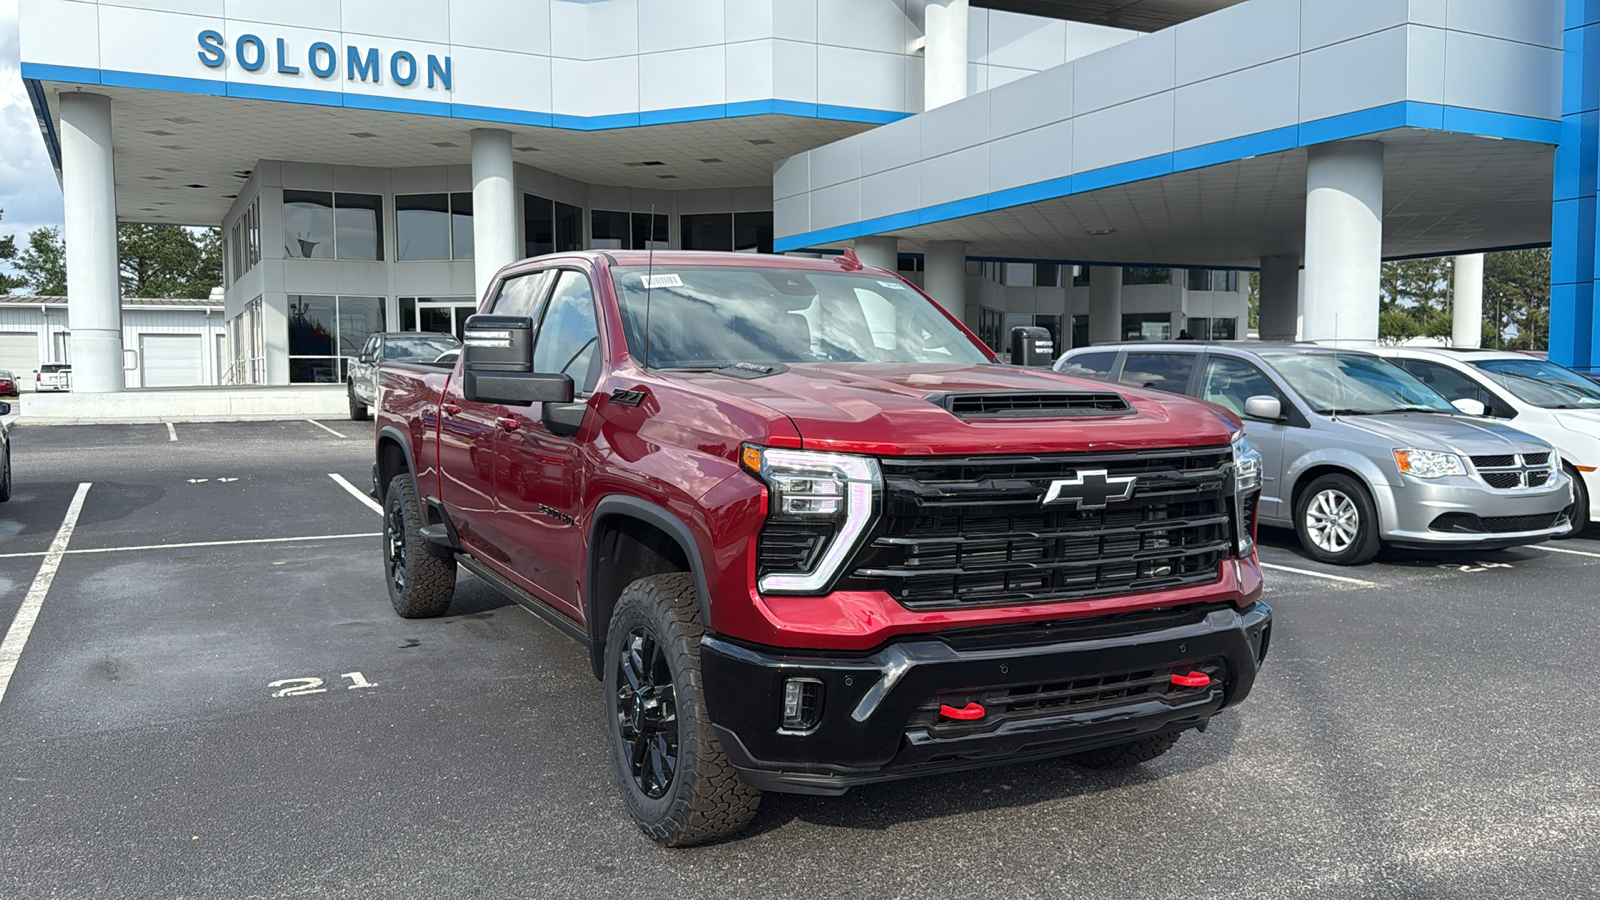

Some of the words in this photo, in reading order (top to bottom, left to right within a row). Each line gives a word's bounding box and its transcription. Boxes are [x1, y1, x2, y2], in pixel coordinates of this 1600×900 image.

[198, 29, 451, 90] SOLOMON
[609, 388, 647, 407] Z71
[268, 672, 379, 697] 21
